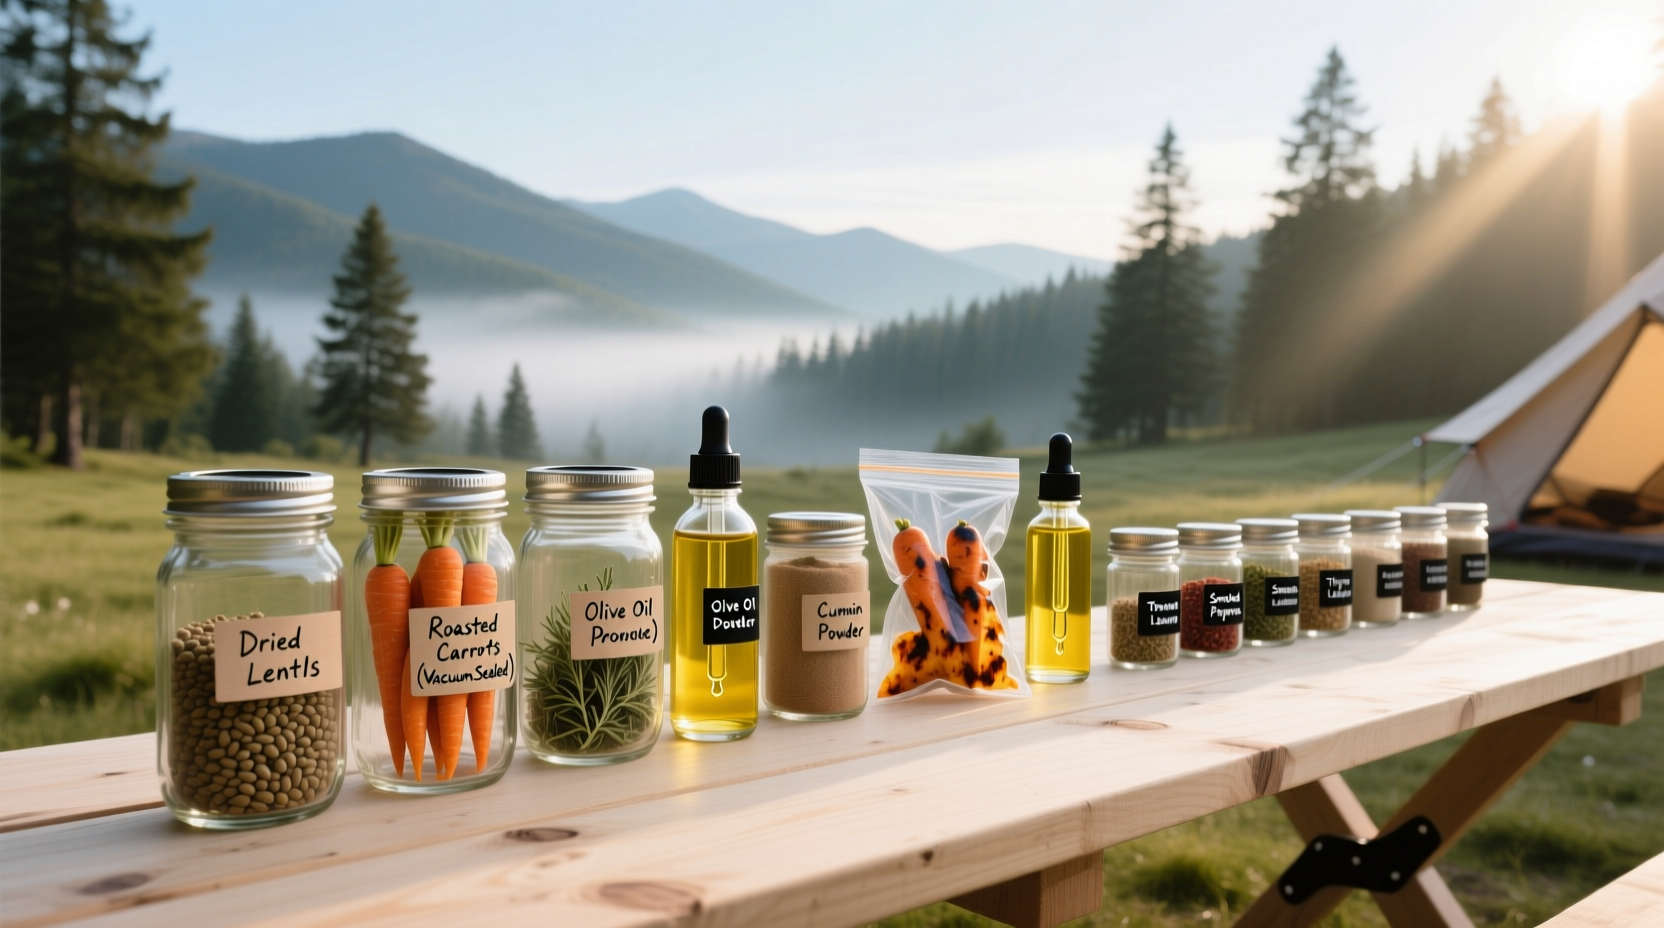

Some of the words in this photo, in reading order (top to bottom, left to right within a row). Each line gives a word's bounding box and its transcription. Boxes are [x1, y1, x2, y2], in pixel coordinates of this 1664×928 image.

[584, 600, 626, 622] Olive
[632, 597, 653, 617] Oil
[428, 612, 499, 640] Roasted
[818, 621, 864, 641] Powder
[239, 625, 301, 658] Dried
[436, 639, 501, 662] Carrots
